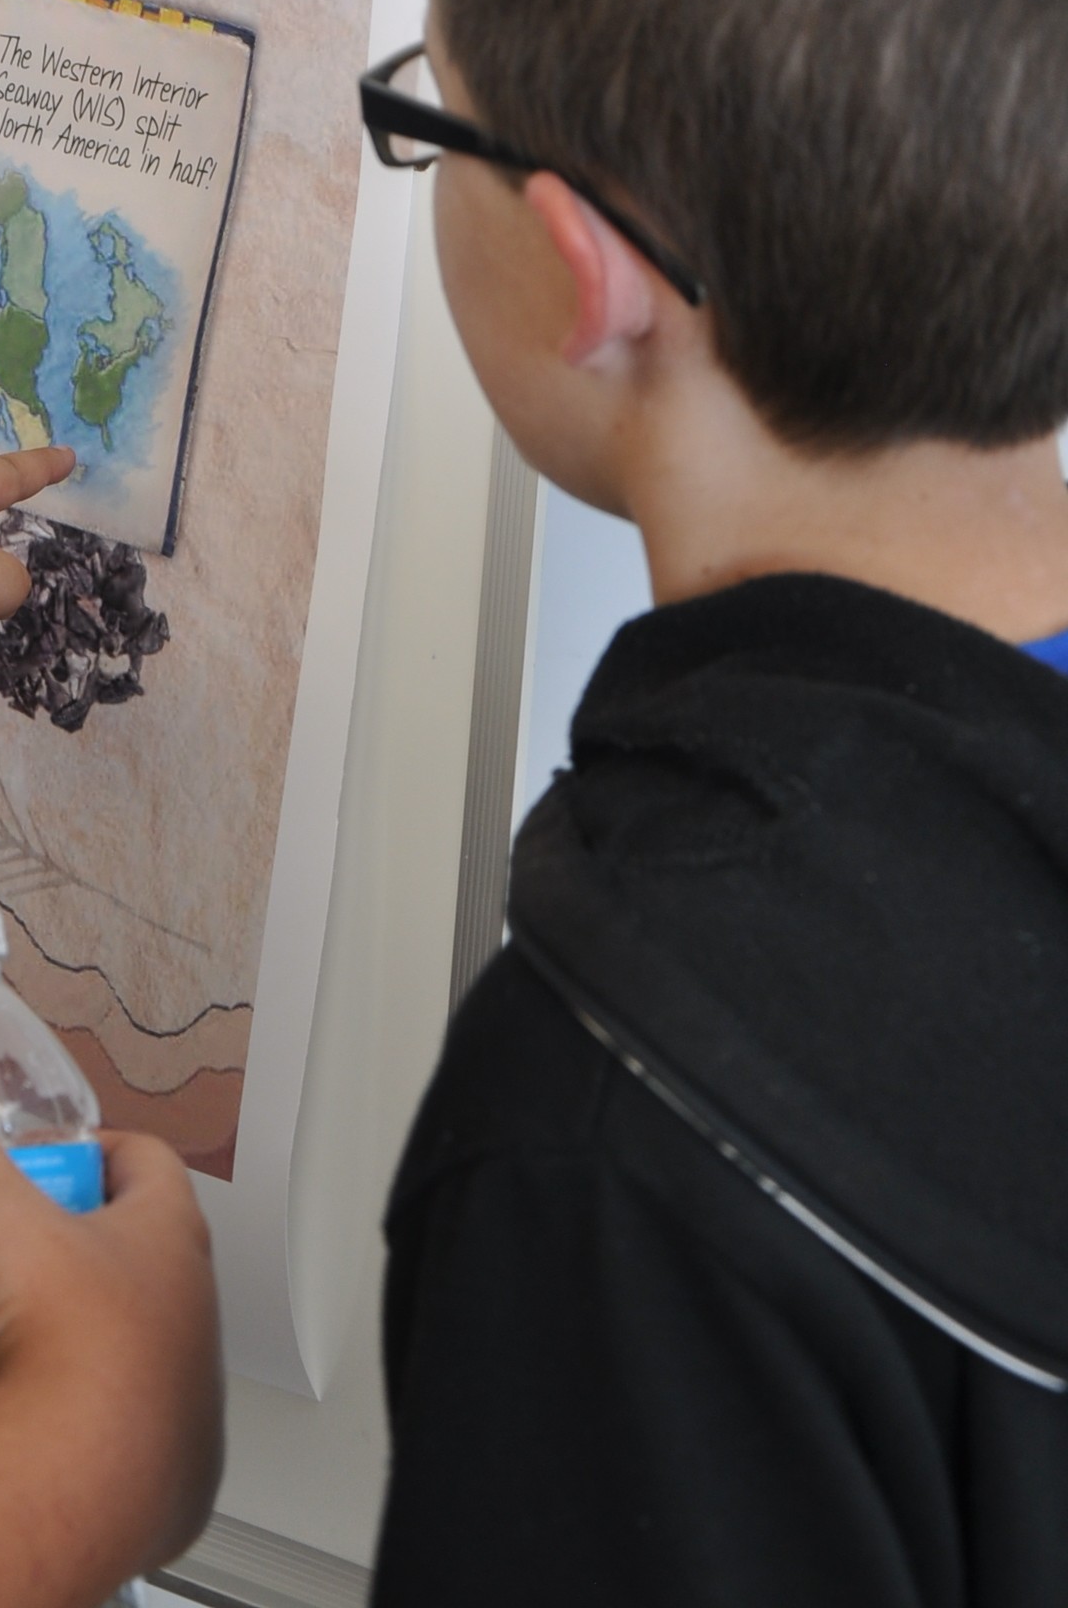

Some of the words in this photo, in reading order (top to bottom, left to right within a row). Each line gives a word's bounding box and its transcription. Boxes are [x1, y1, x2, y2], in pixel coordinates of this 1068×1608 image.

[0, 33, 33, 70] The
[41, 43, 124, 92] Western
[132, 65, 210, 110] Interior
[72, 87, 126, 132] (WIS)
[134, 109, 183, 155] split
[51, 123, 132, 169] America
[140, 148, 163, 177] in
[168, 148, 218, 188] half!
